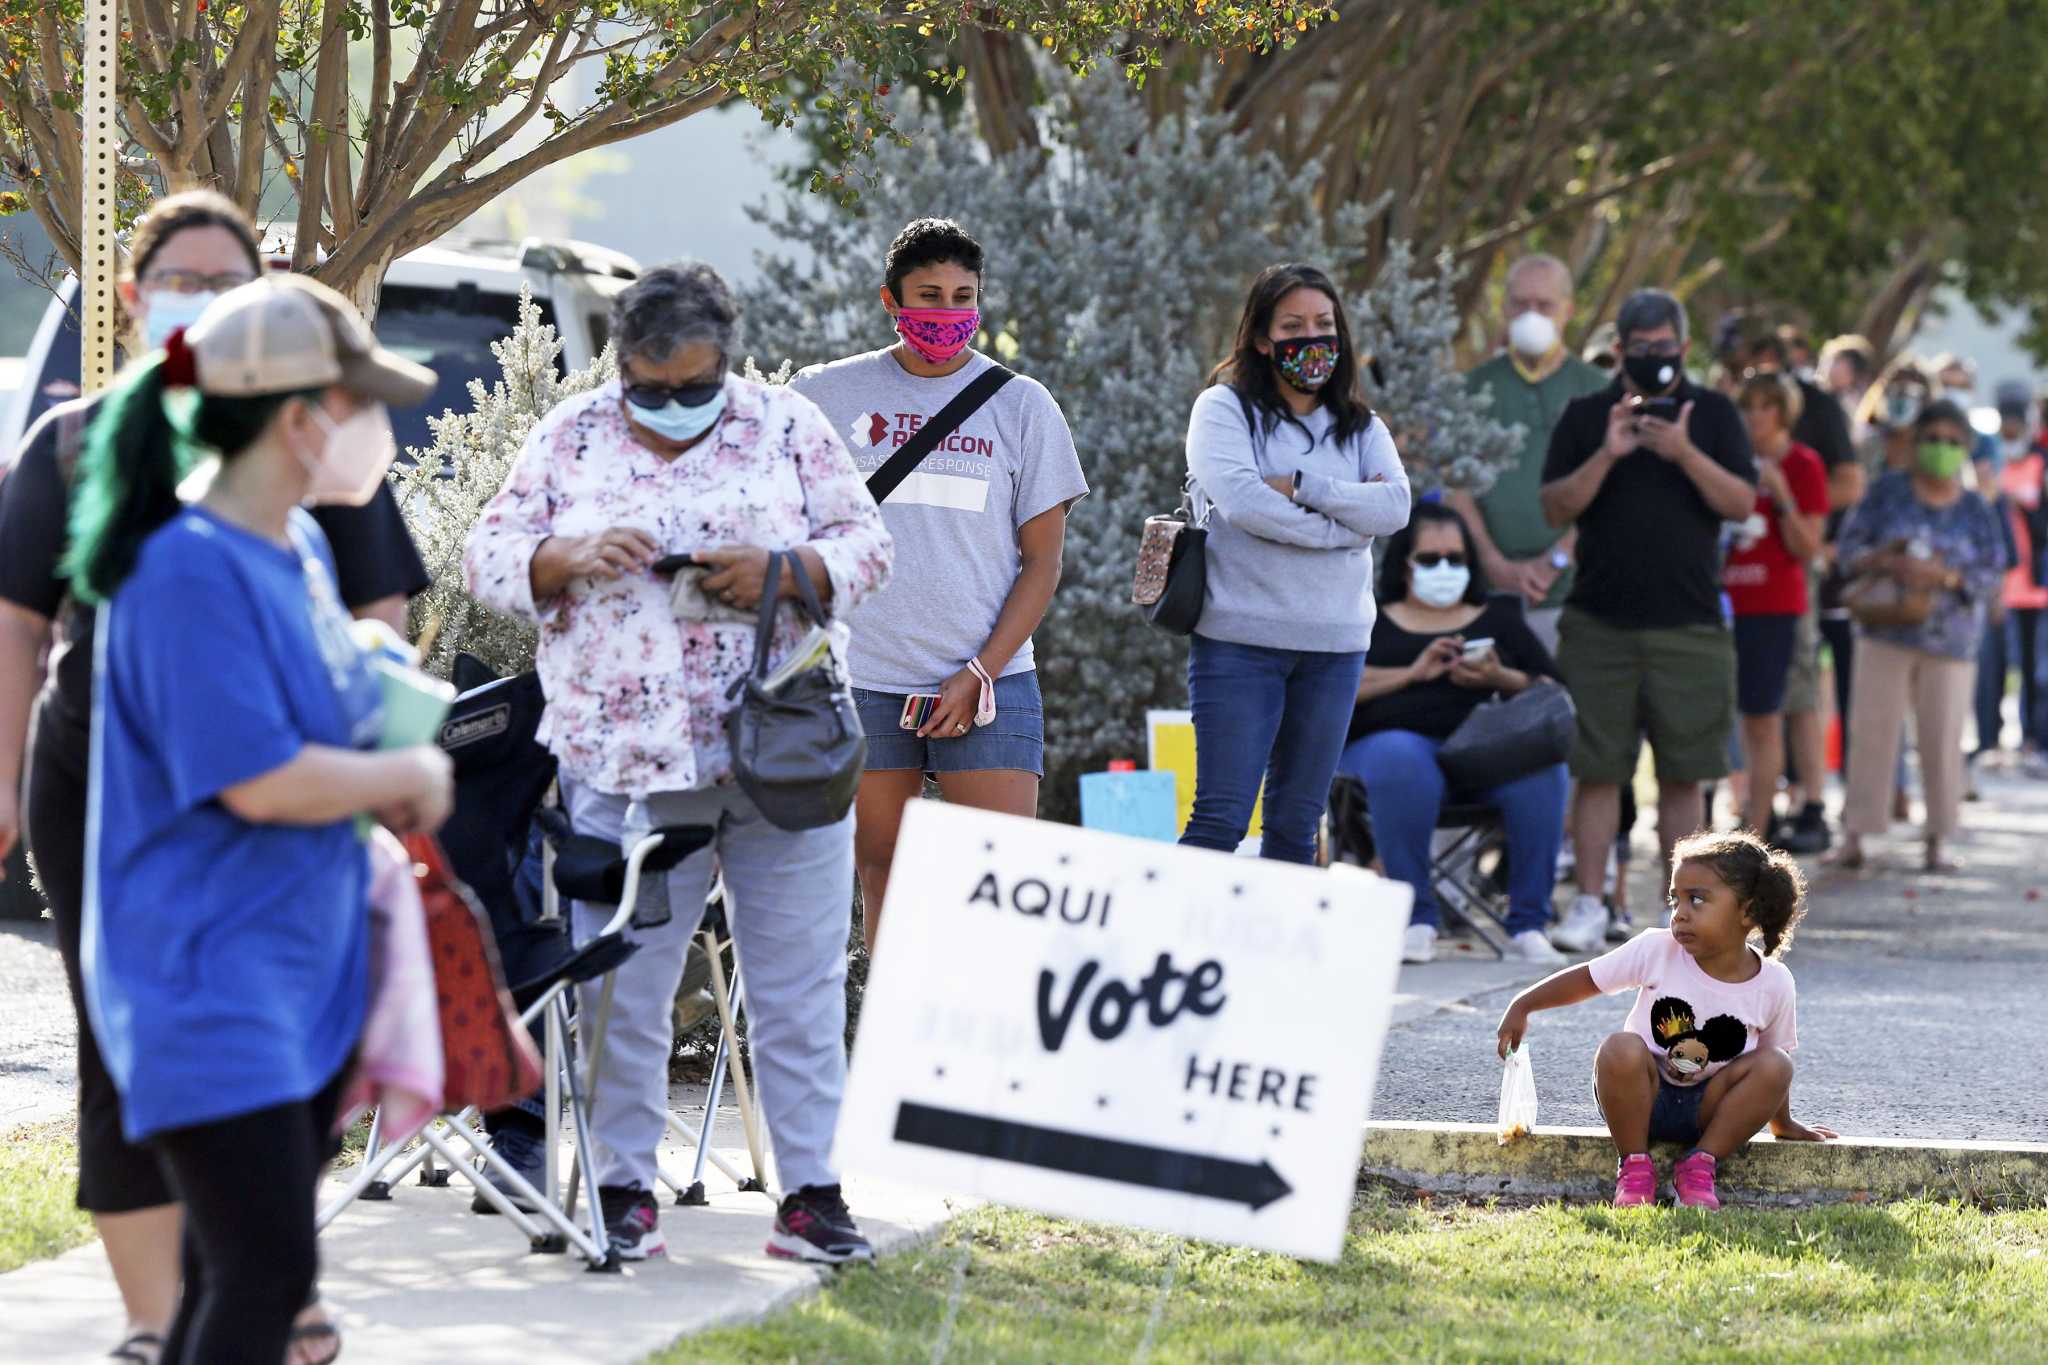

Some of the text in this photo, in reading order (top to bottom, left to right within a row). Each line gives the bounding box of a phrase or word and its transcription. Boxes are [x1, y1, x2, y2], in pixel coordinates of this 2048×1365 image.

[918, 457, 992, 477] RESPONSE
[969, 872, 1112, 927] AQUI
[1036, 953, 1226, 1052] Vote
[1185, 1056, 1317, 1113] HERE
